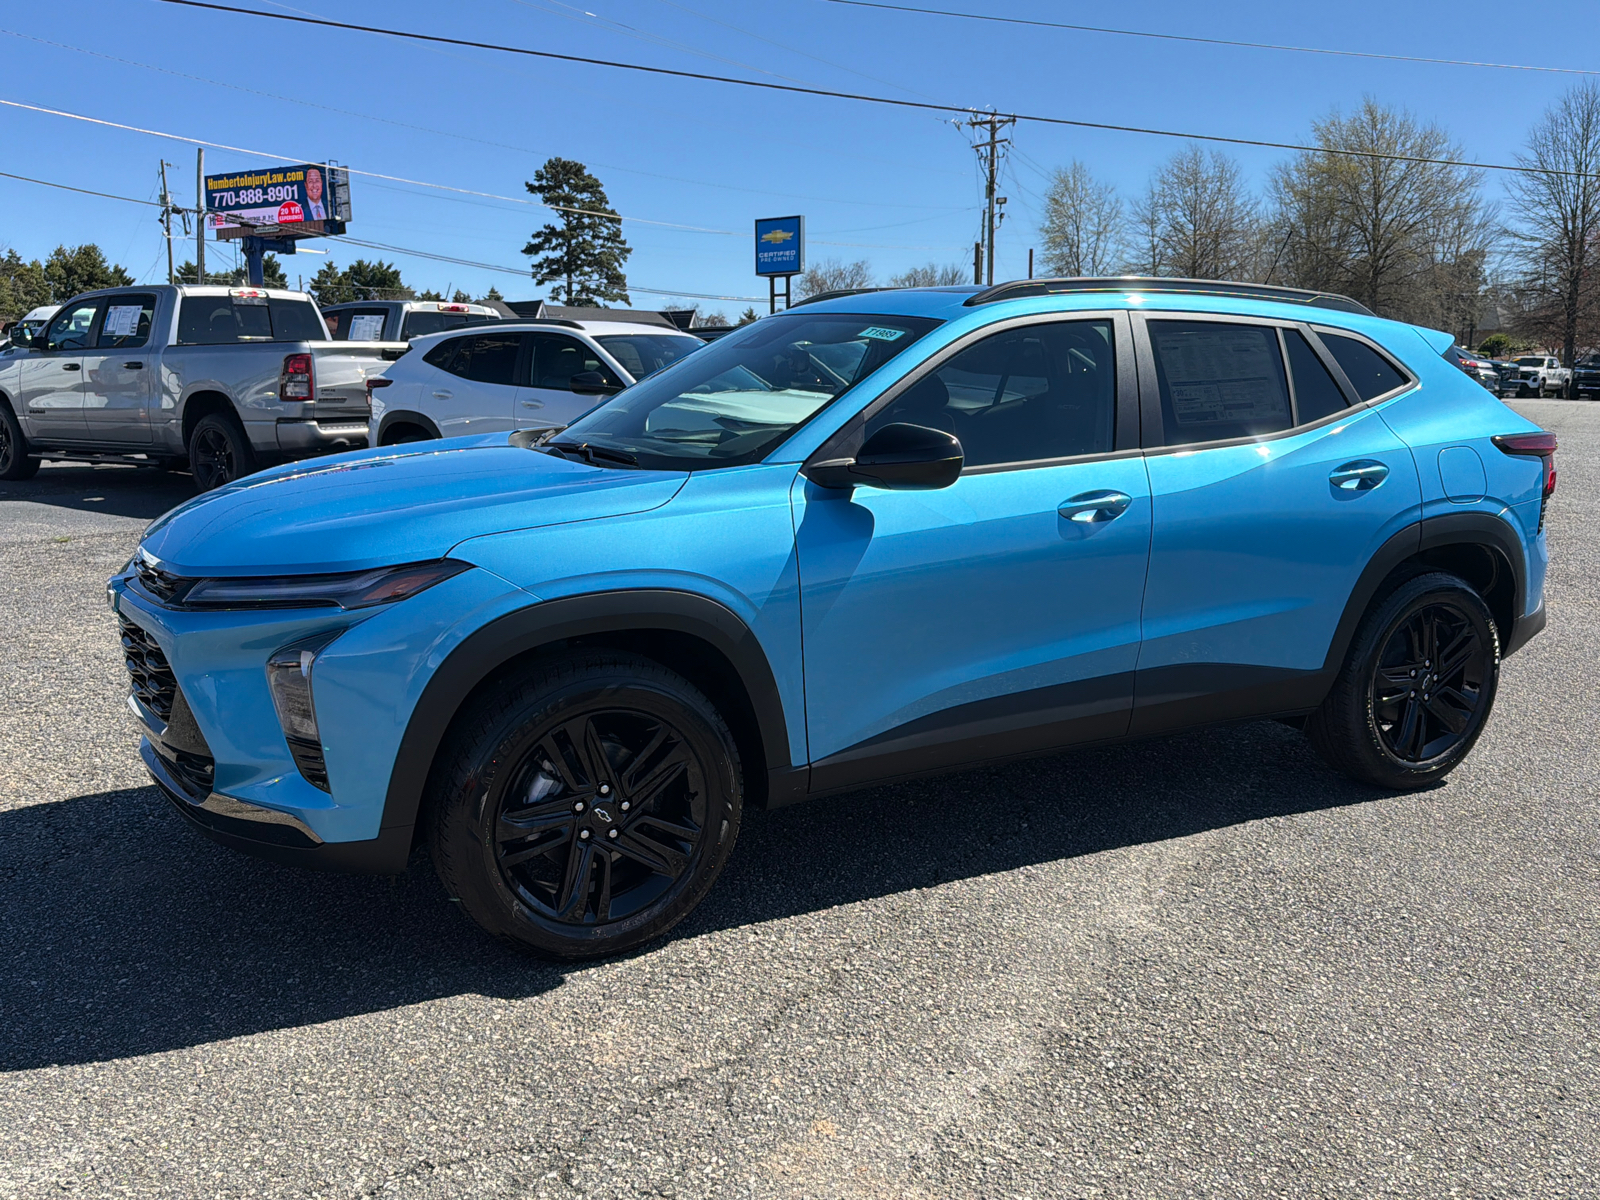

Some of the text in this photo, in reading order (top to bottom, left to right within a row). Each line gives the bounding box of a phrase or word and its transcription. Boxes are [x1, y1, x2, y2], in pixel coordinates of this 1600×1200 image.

[207, 171, 304, 190] HumbertoInjuryLaw.com
[212, 184, 299, 207] 770-888-8901
[280, 206, 301, 215] 20 YR
[759, 250, 796, 258] CERTIFIED
